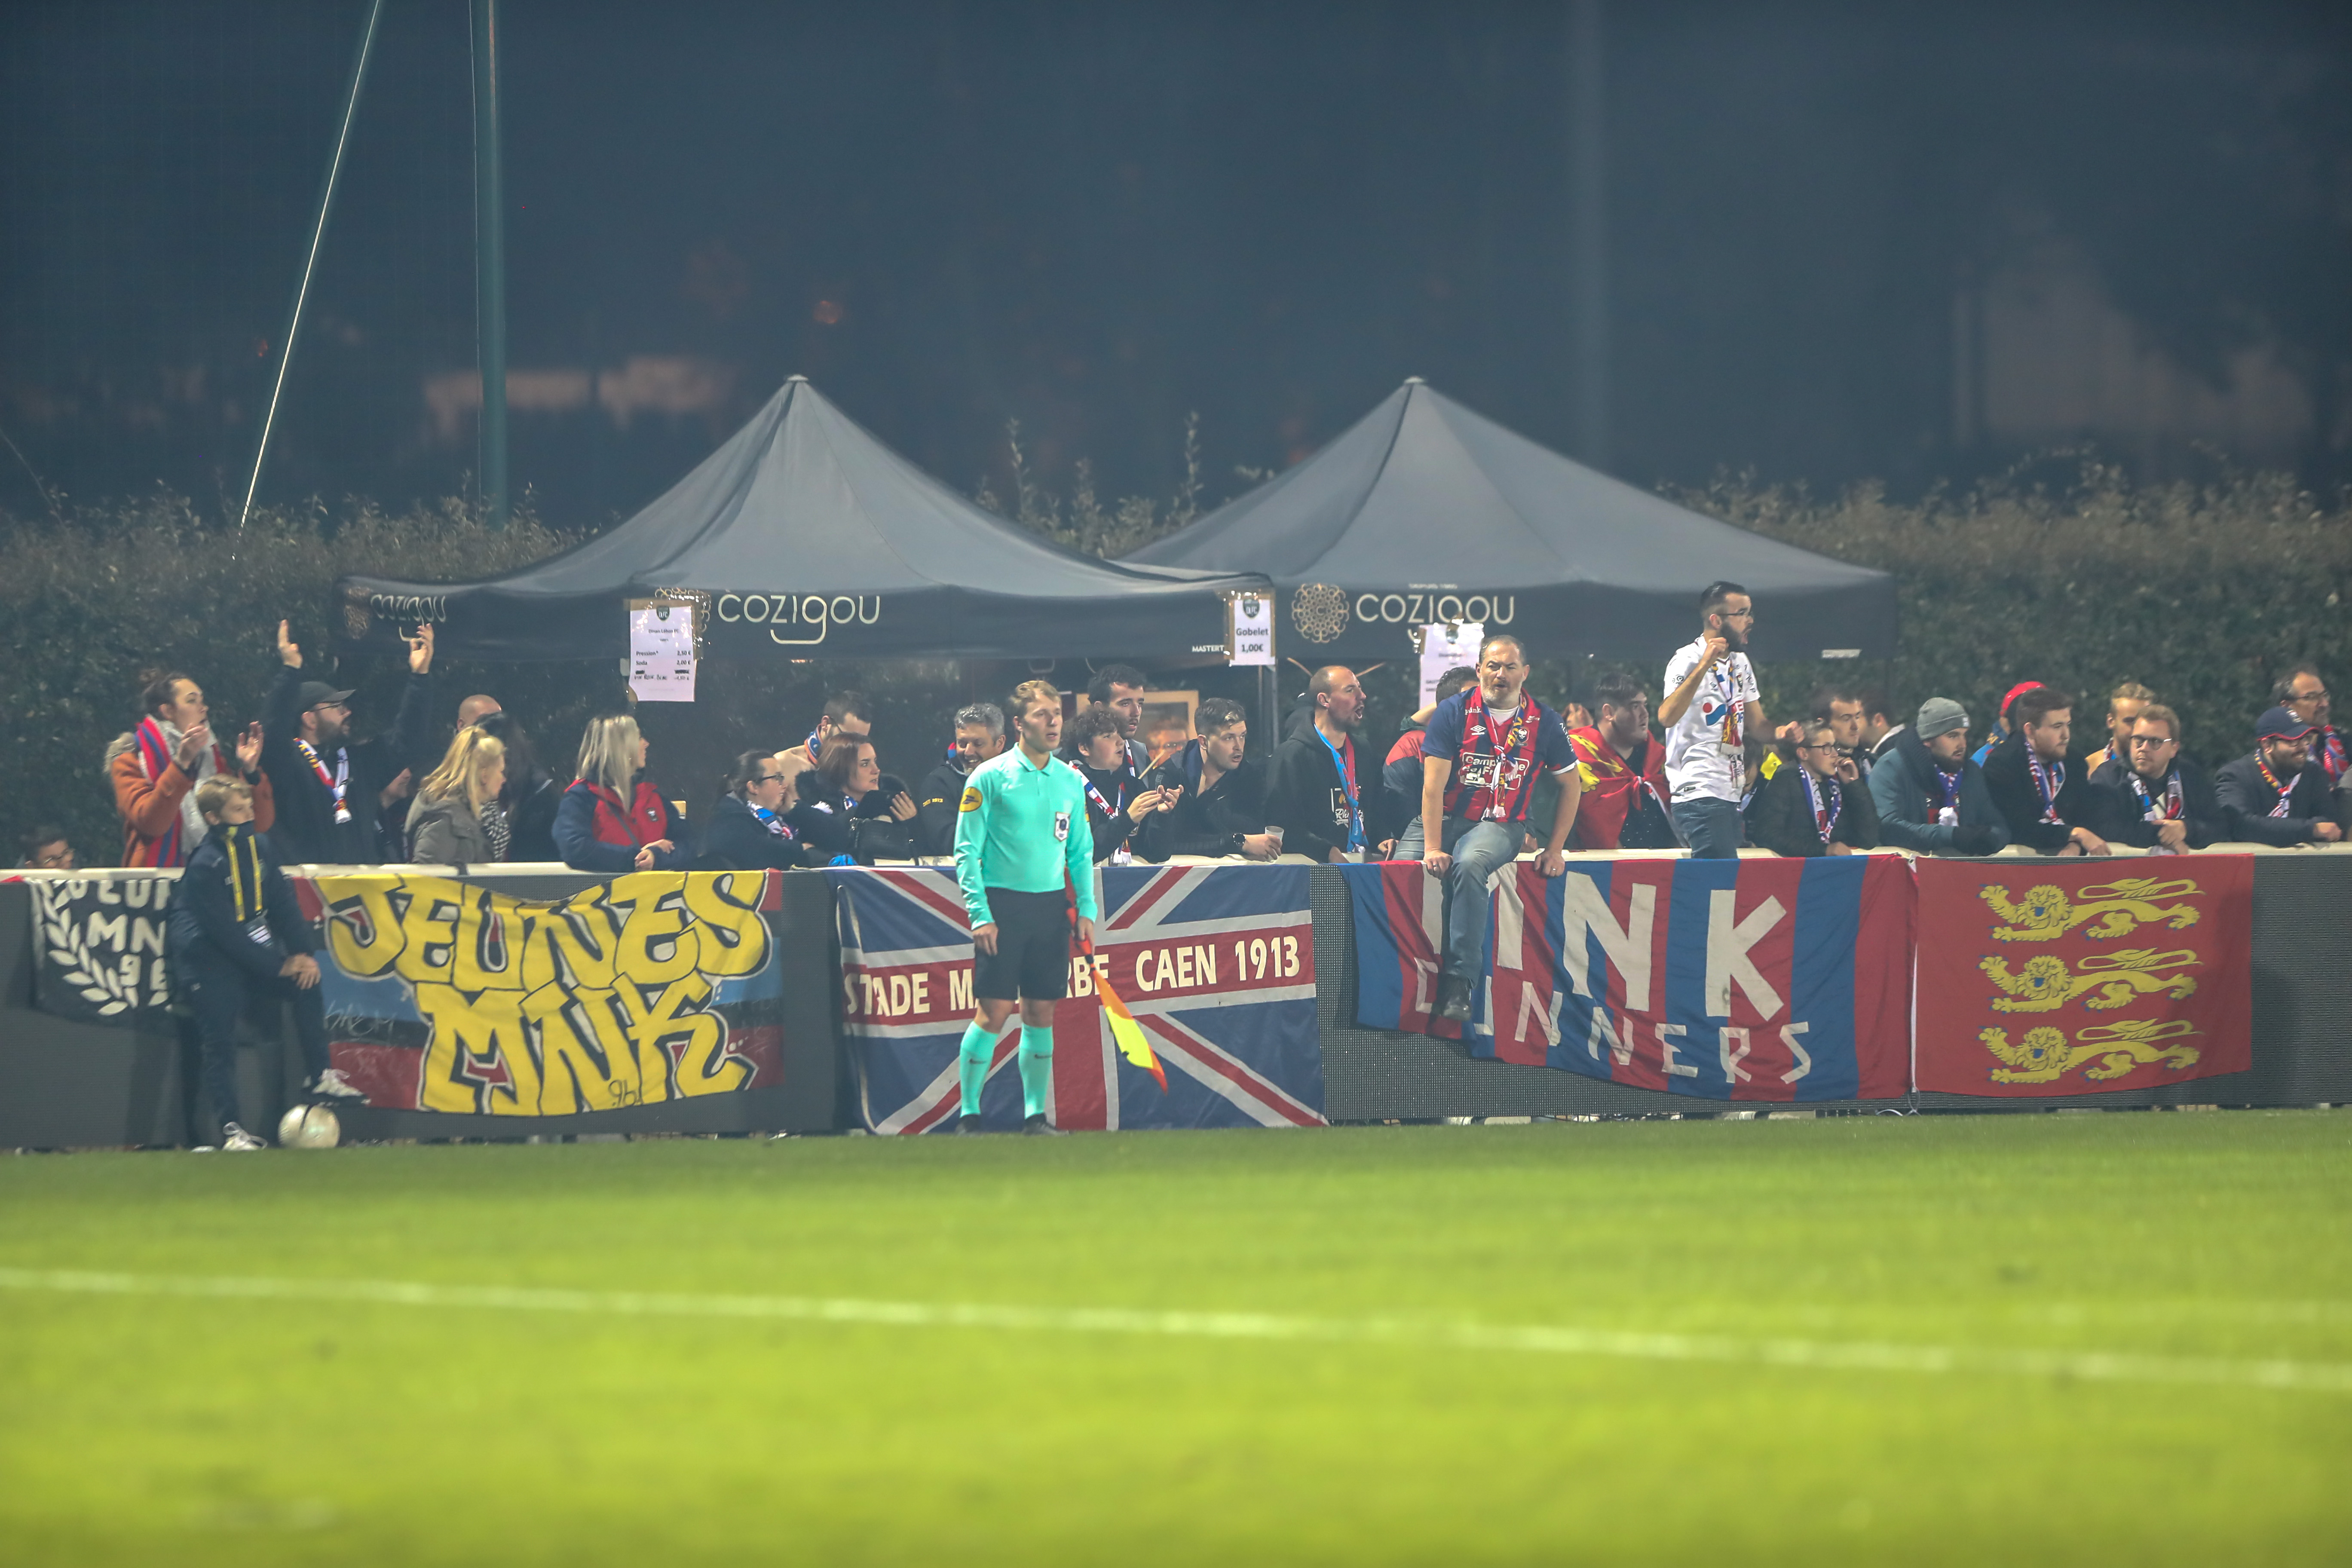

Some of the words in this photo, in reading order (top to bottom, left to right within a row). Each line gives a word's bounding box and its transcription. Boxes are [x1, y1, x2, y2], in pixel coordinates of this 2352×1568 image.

[1241, 644, 1263, 652] 1,00€
[325, 871, 773, 992] JEUNES
[844, 972, 930, 1017] STADE
[1136, 944, 1217, 992] CAEN
[1235, 935, 1300, 981] 1913
[416, 972, 759, 1117] MNK
